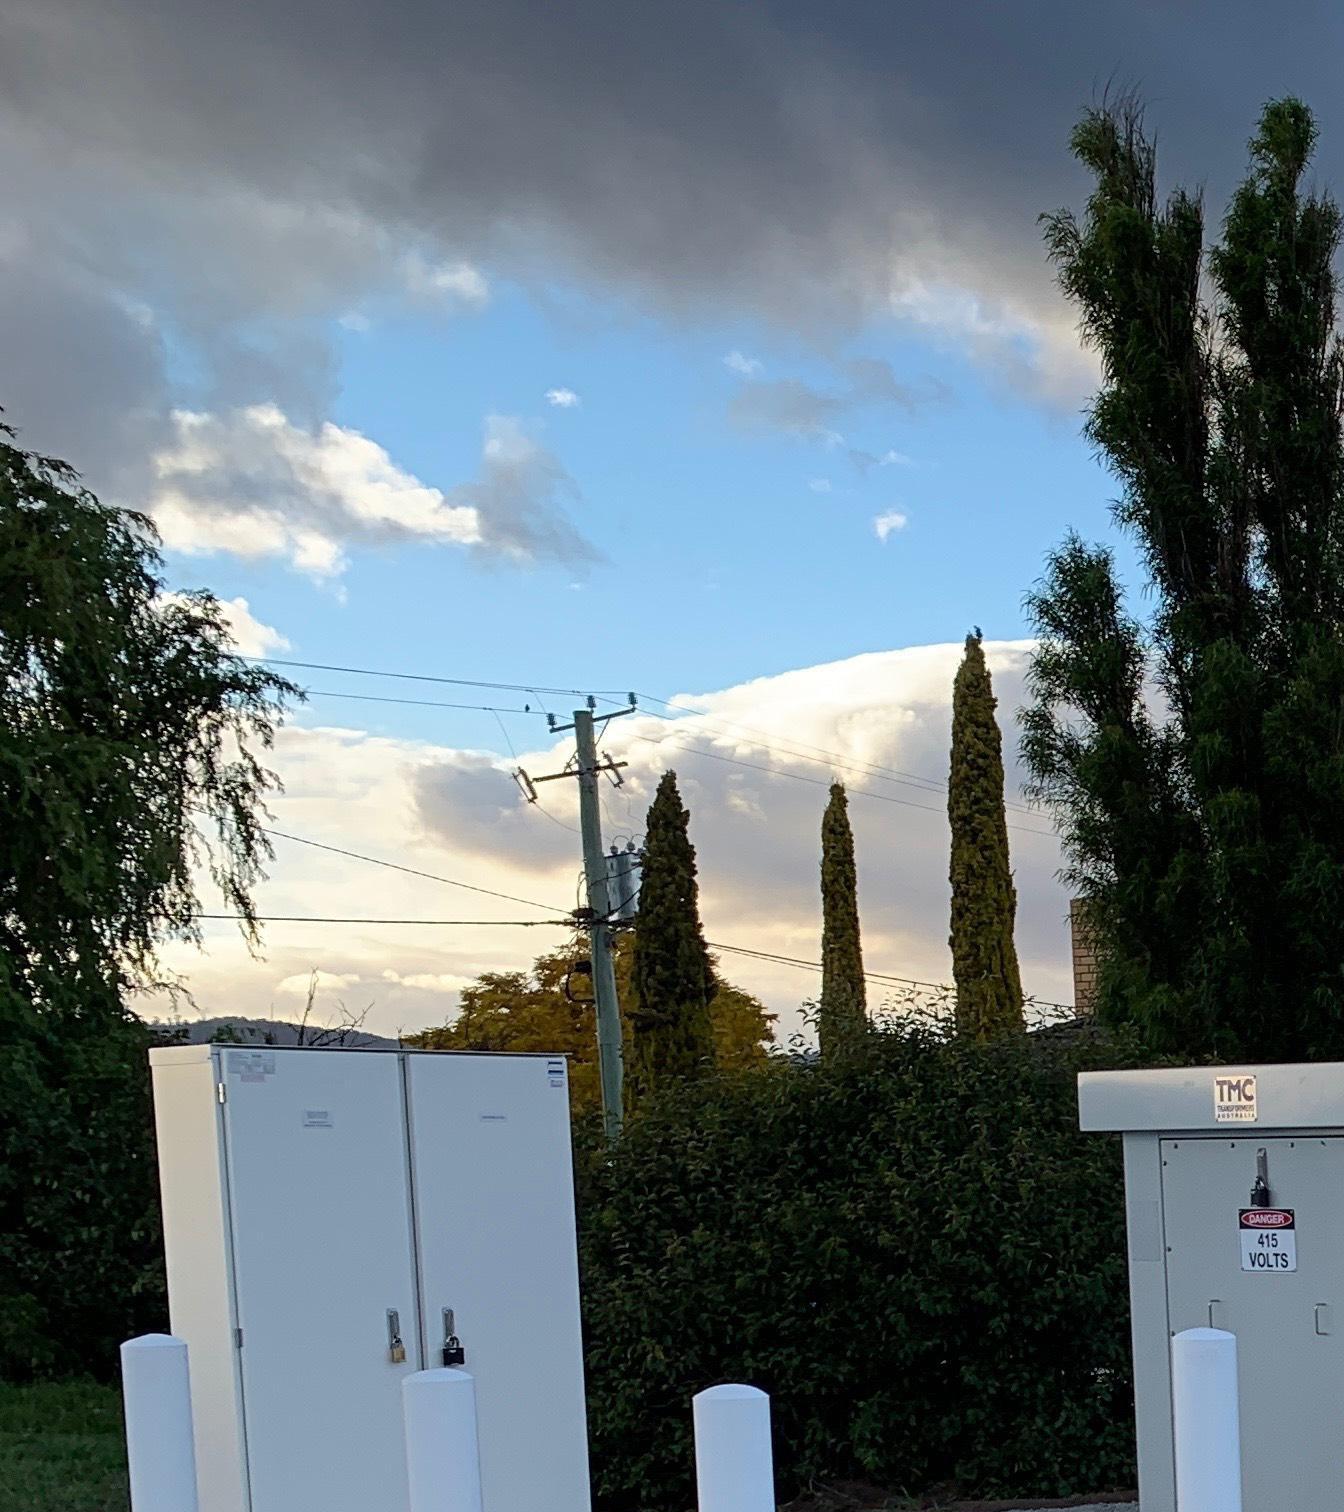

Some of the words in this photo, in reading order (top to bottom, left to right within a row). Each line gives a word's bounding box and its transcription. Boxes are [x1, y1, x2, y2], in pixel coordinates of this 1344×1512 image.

[1215, 1078, 1255, 1102] TMC
[1216, 1104, 1255, 1112] TRANSFORMERS
[1249, 1214, 1285, 1224] DANGER
[1257, 1233, 1279, 1248] 415
[1248, 1252, 1289, 1269] VOLTS
